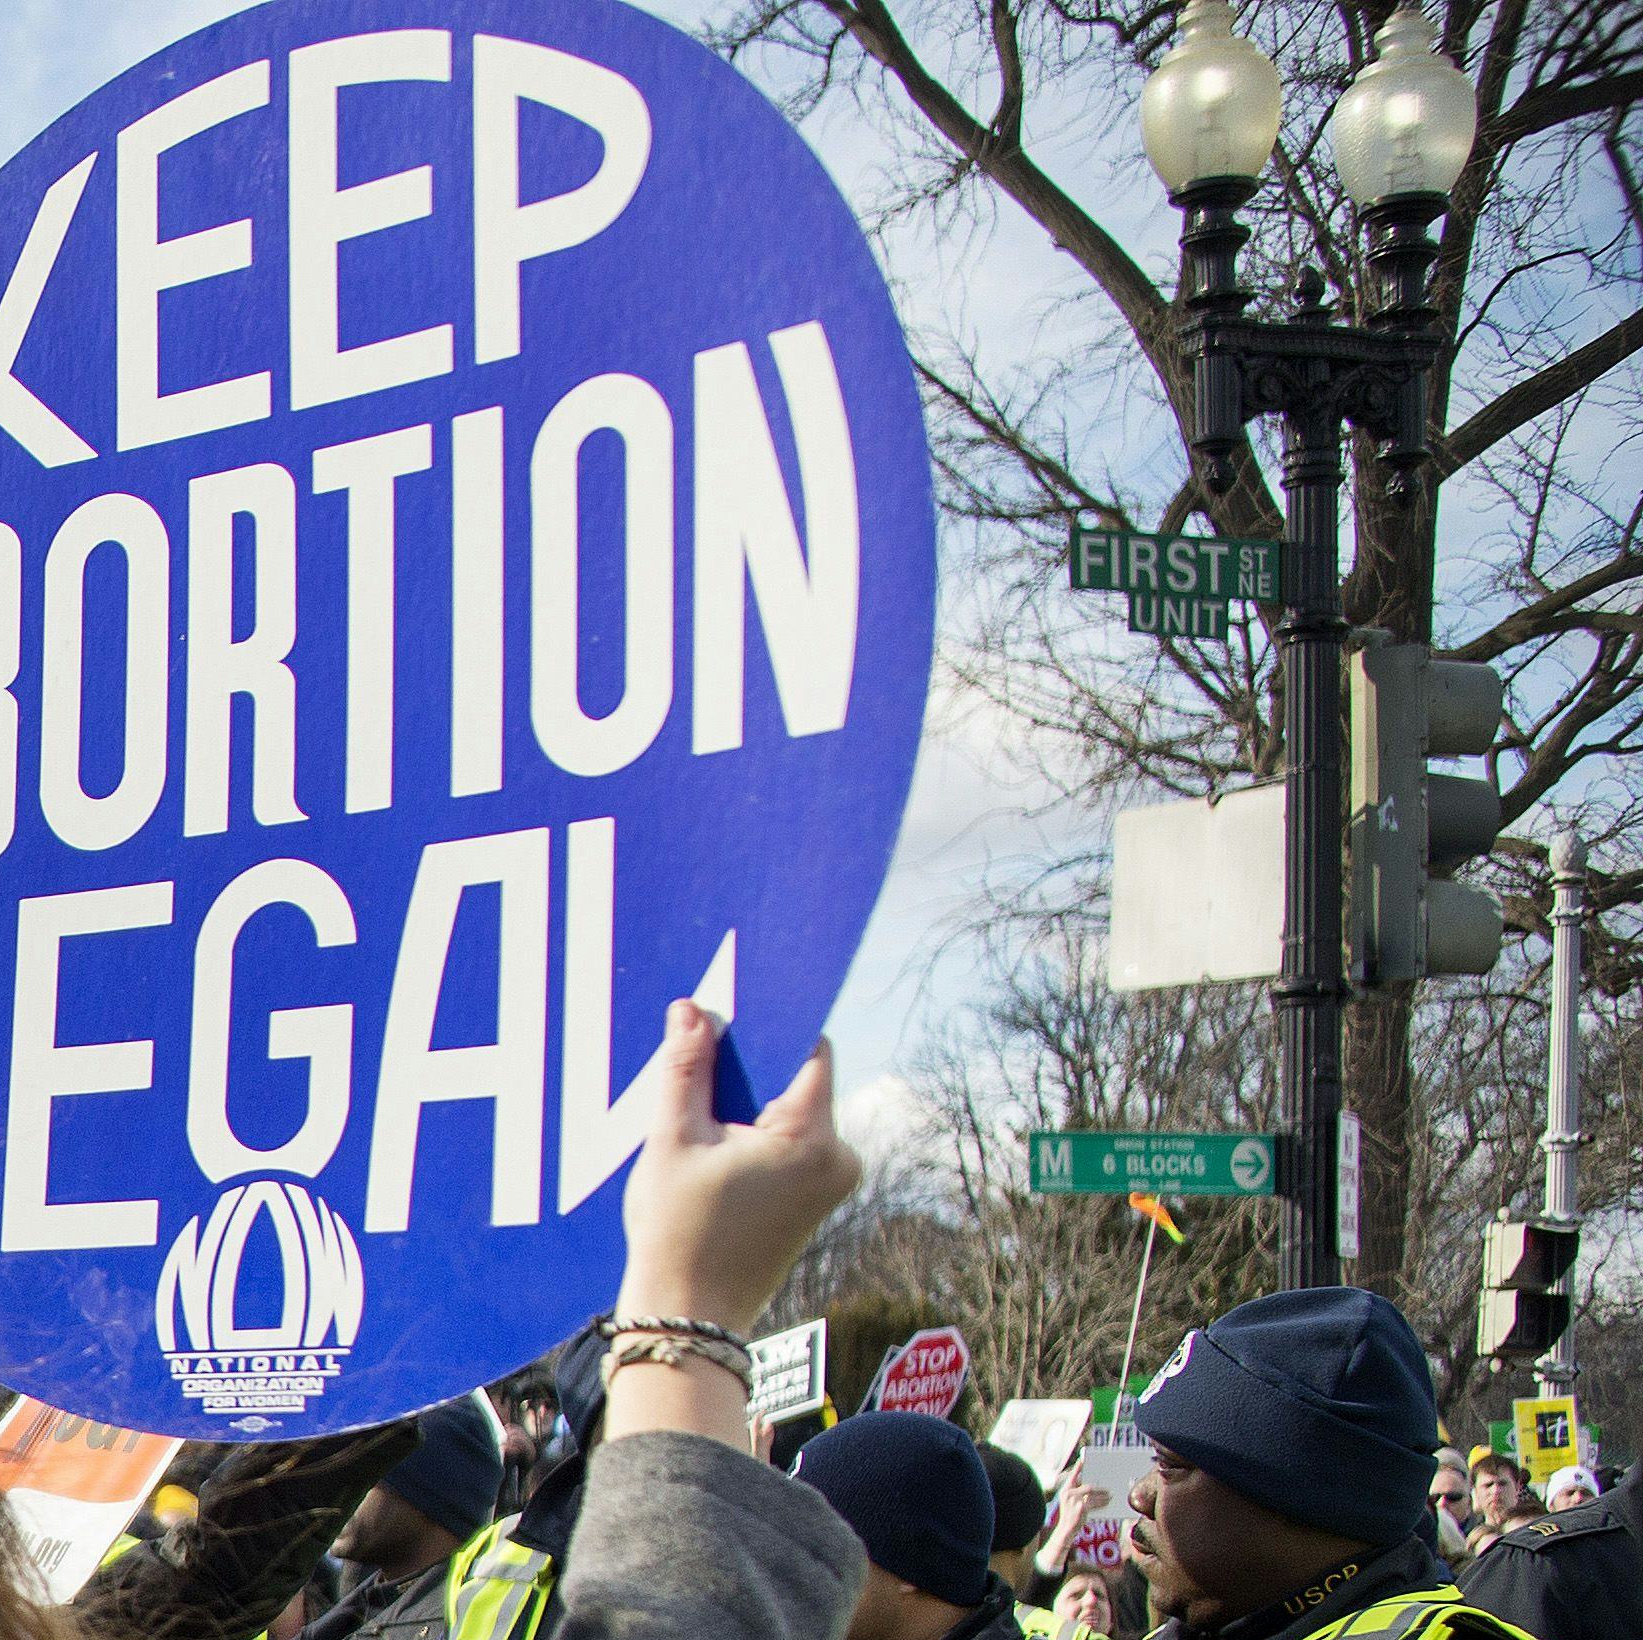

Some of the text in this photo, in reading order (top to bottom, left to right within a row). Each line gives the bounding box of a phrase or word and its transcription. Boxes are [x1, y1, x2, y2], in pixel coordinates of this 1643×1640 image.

[1079, 532, 1269, 594] FIRST ST
[1239, 572, 1273, 598] NE
[1134, 592, 1224, 637] UNIT
[1126, 1153, 1206, 1177] BLOCKS
[155, 1180, 365, 1352] NOW
[170, 1355, 341, 1374] NATIONAL
[903, 1343, 957, 1377] STOP
[182, 1376, 325, 1393] ORGANIZATION
[885, 1369, 963, 1399] ABORTION
[202, 1394, 306, 1409] FOR WOMEN
[1284, 1563, 1359, 1615] USCP
